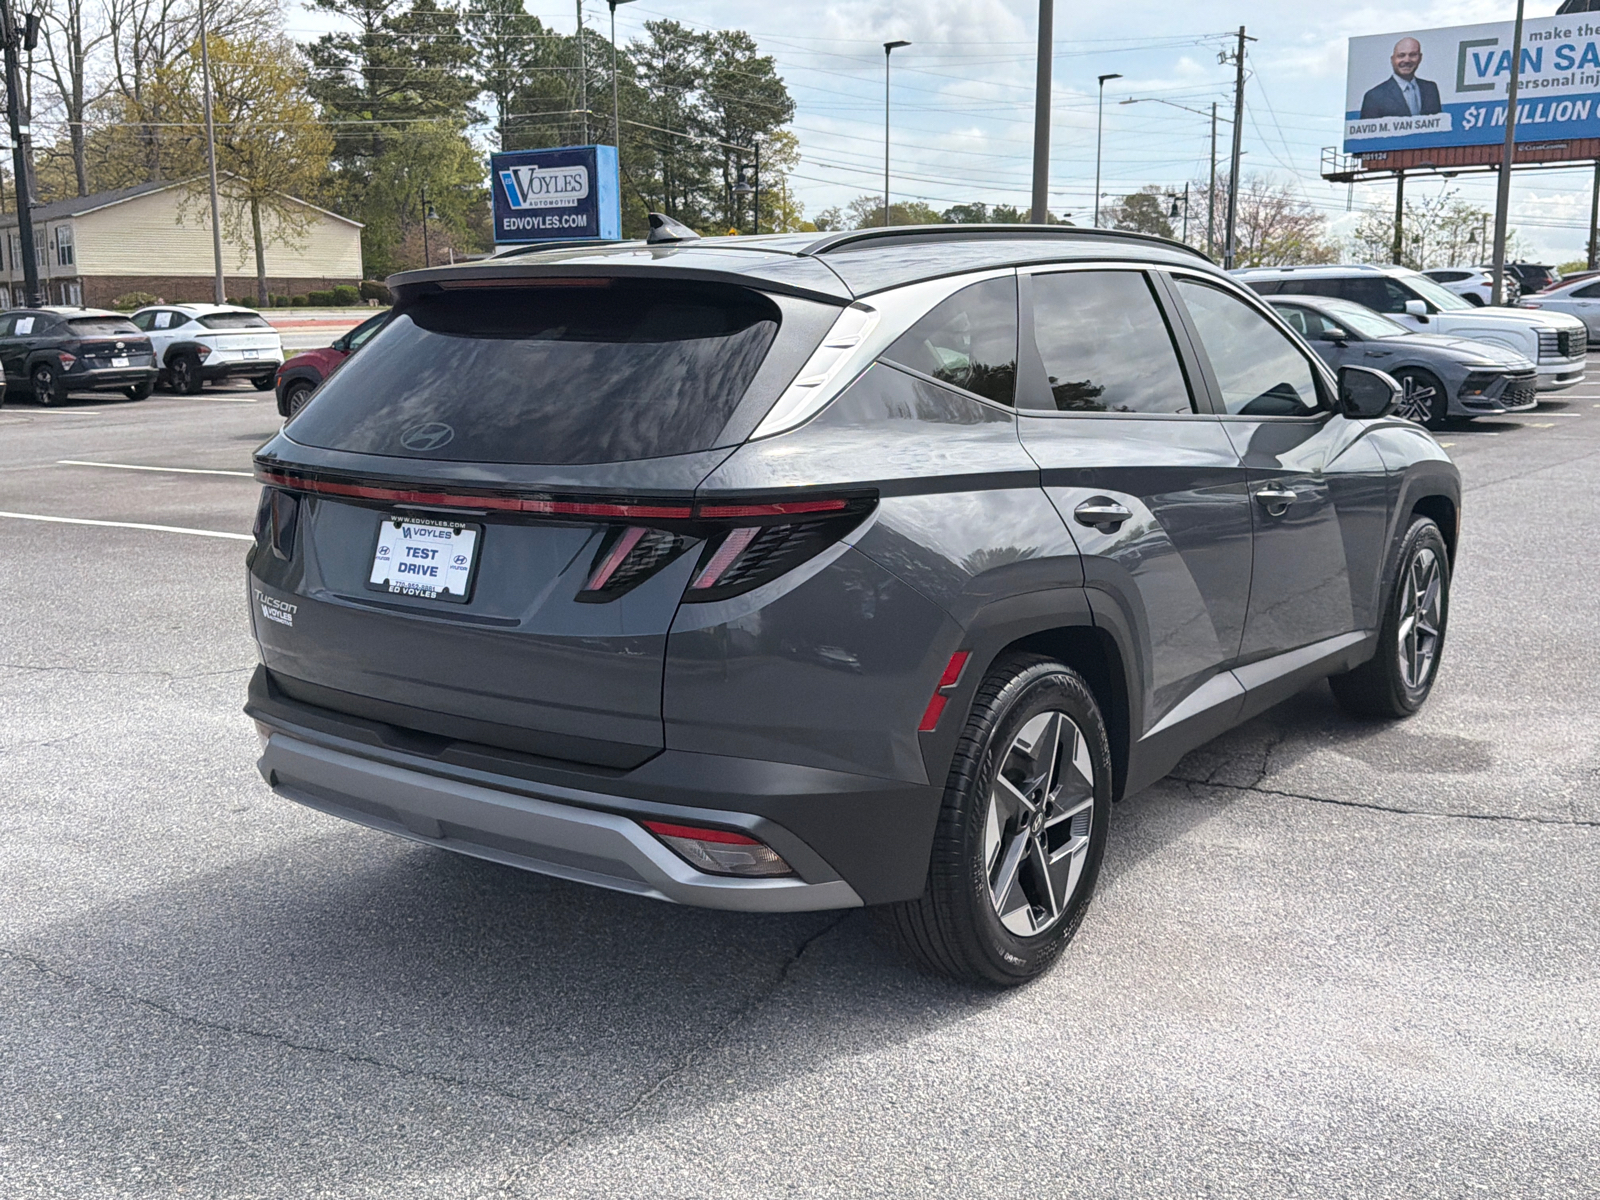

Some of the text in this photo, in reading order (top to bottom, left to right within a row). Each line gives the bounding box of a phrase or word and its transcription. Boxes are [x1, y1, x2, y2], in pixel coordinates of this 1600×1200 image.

[1529, 27, 1572, 41] make
[1472, 47, 1543, 77] VAN
[1462, 105, 1487, 130] $1
[1490, 100, 1591, 126] MILLION
[1349, 118, 1441, 135] DAVID M. VAN SANT
[512, 168, 583, 203] VOYLES
[529, 199, 576, 207] AUTOMOTIVE
[503, 215, 587, 230] EDVOYLES.COM
[391, 516, 466, 528] WWW.EDVOYLES.COM
[413, 528, 452, 539] VOYLES
[406, 546, 439, 560] TEST
[398, 562, 439, 577] DRIVE
[388, 585, 437, 599] ED VOYLES
